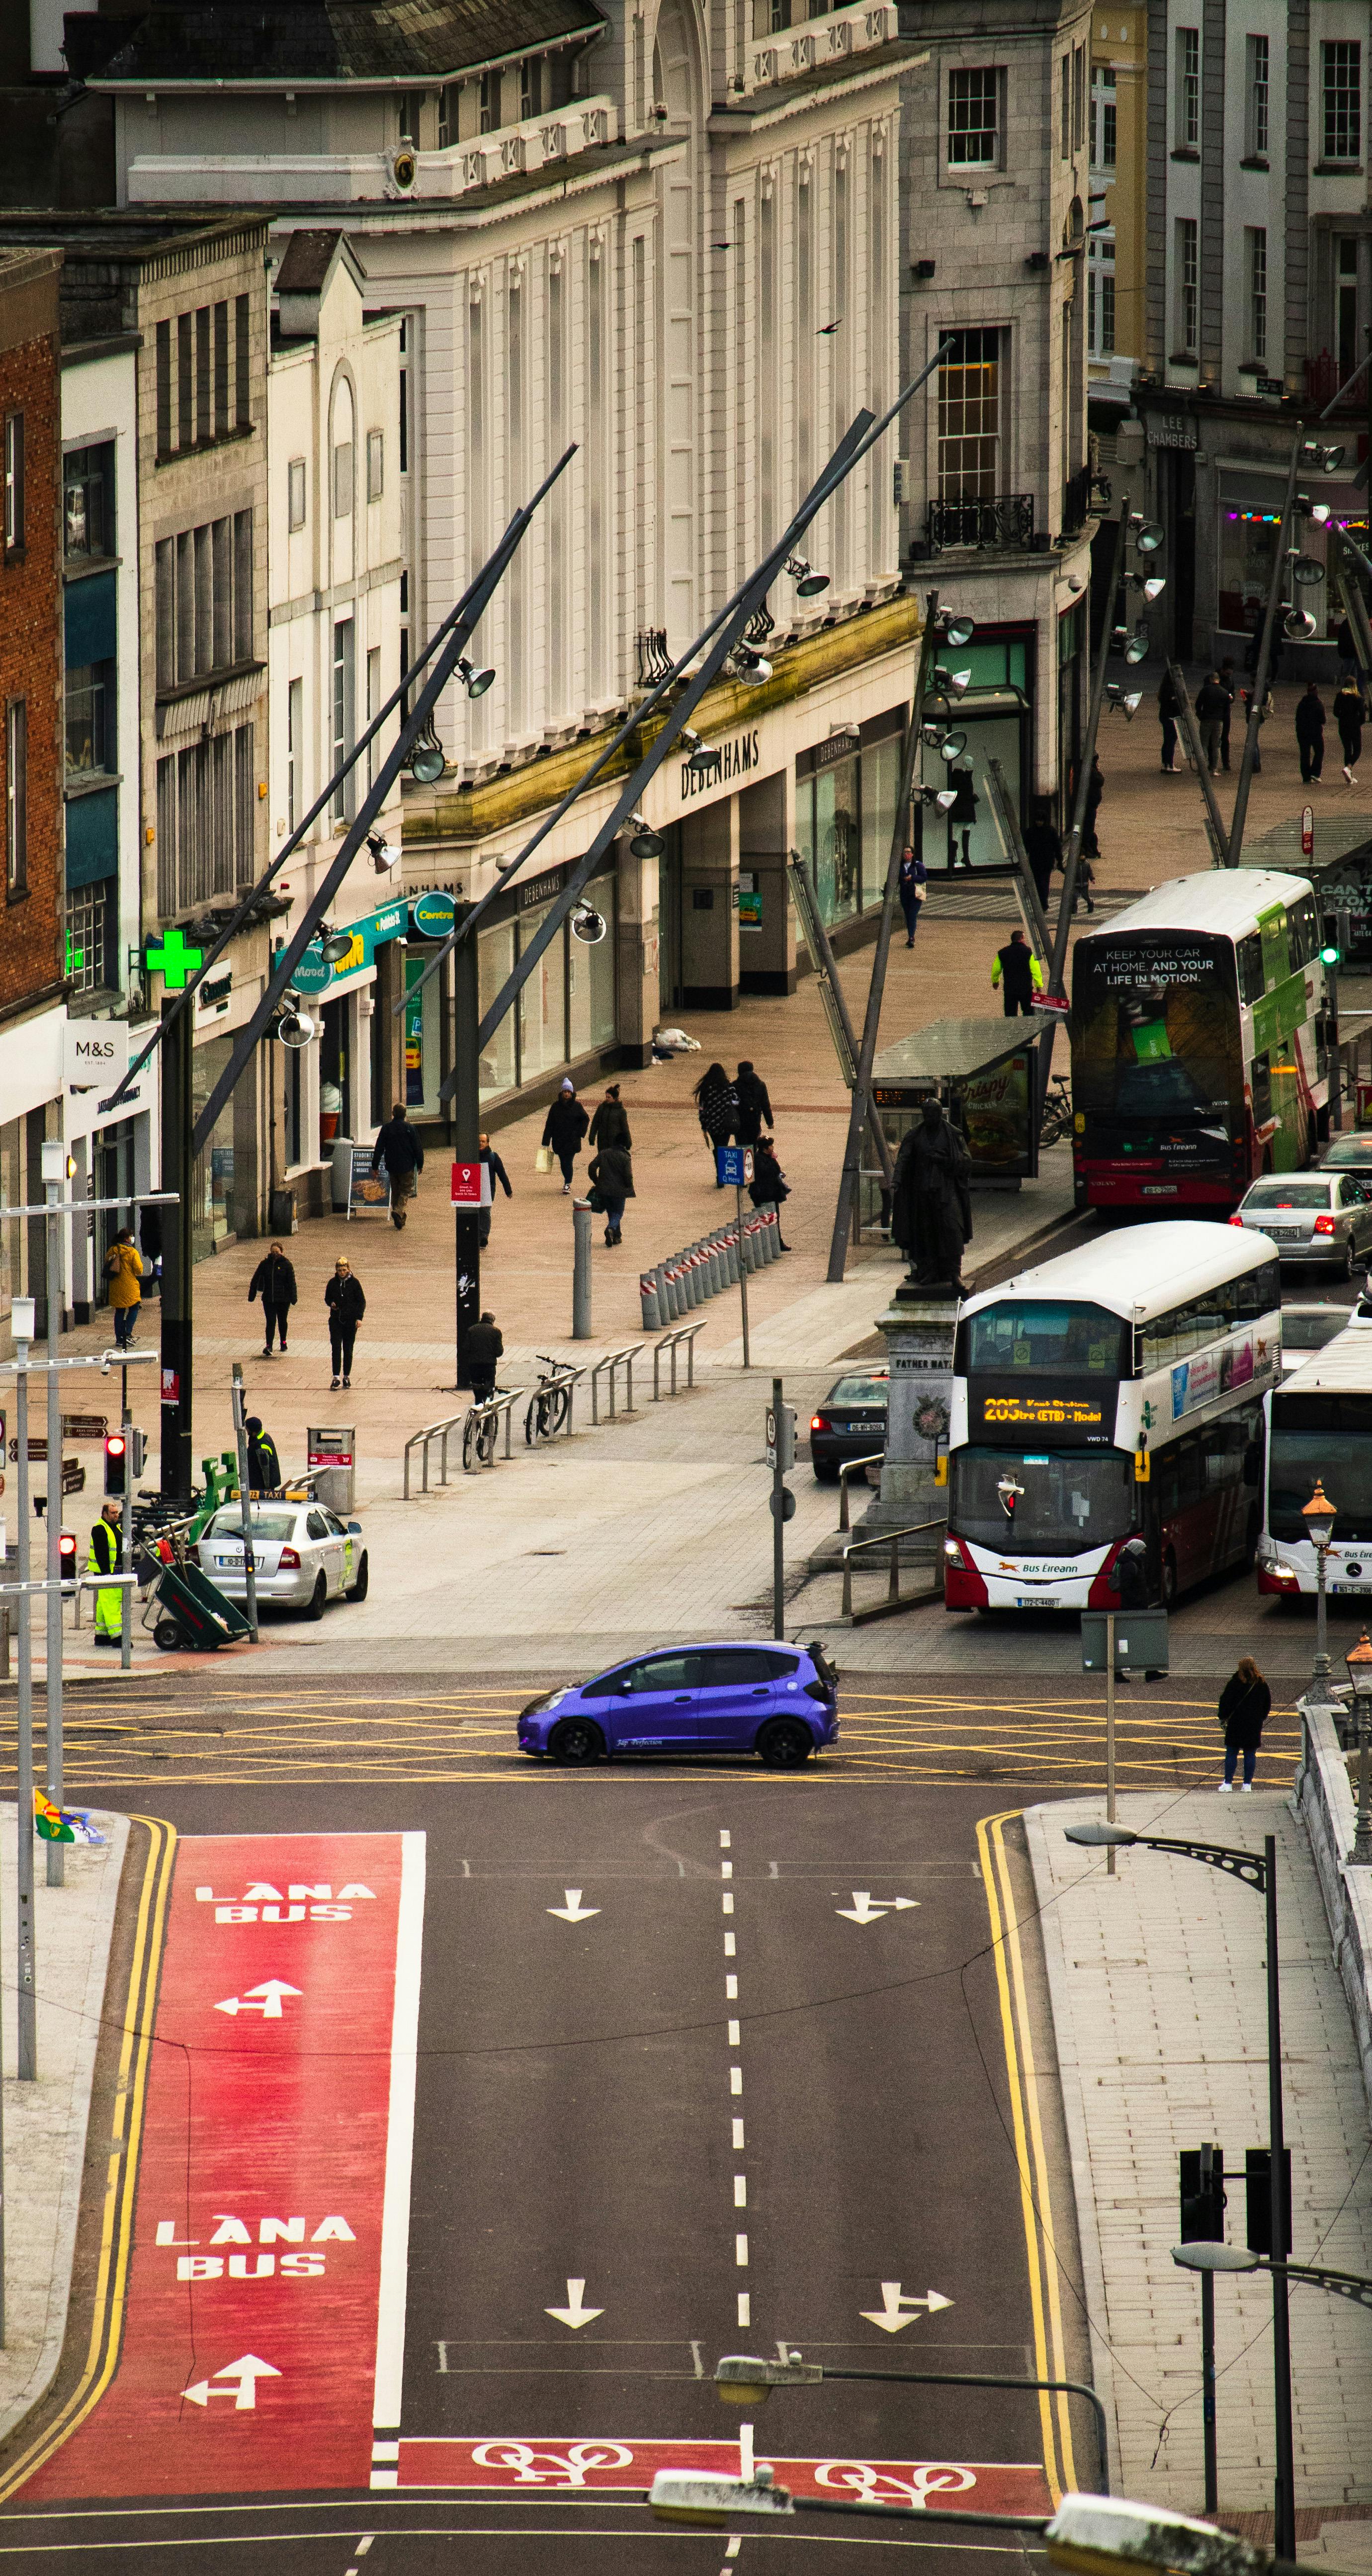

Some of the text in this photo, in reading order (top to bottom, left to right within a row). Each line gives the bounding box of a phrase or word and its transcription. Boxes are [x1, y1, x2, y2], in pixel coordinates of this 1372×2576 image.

[1163, 416, 1183, 430] LEE
[1147, 432, 1198, 449] CHAMBERS
[524, 874, 559, 904] DEBENHAMS
[419, 910, 453, 920] Centra
[1106, 948, 1200, 960] KEEP YOUR CAR
[1094, 960, 1214, 973] AT HOME. AND YOUR
[1107, 973, 1201, 985] LIFE IN MOTION.
[76, 1041, 114, 1057] M&S
[896, 1359, 928, 1368] FATHER
[1037, 1410, 1065, 1422] (ETB)
[1074, 1411, 1102, 1422] Model
[263, 1491, 282, 1500] TAXI
[1023, 1563, 1078, 1573] Bus Éireann
[215, 1905, 353, 1924] BUS
[176, 2253, 326, 2282] BUS
